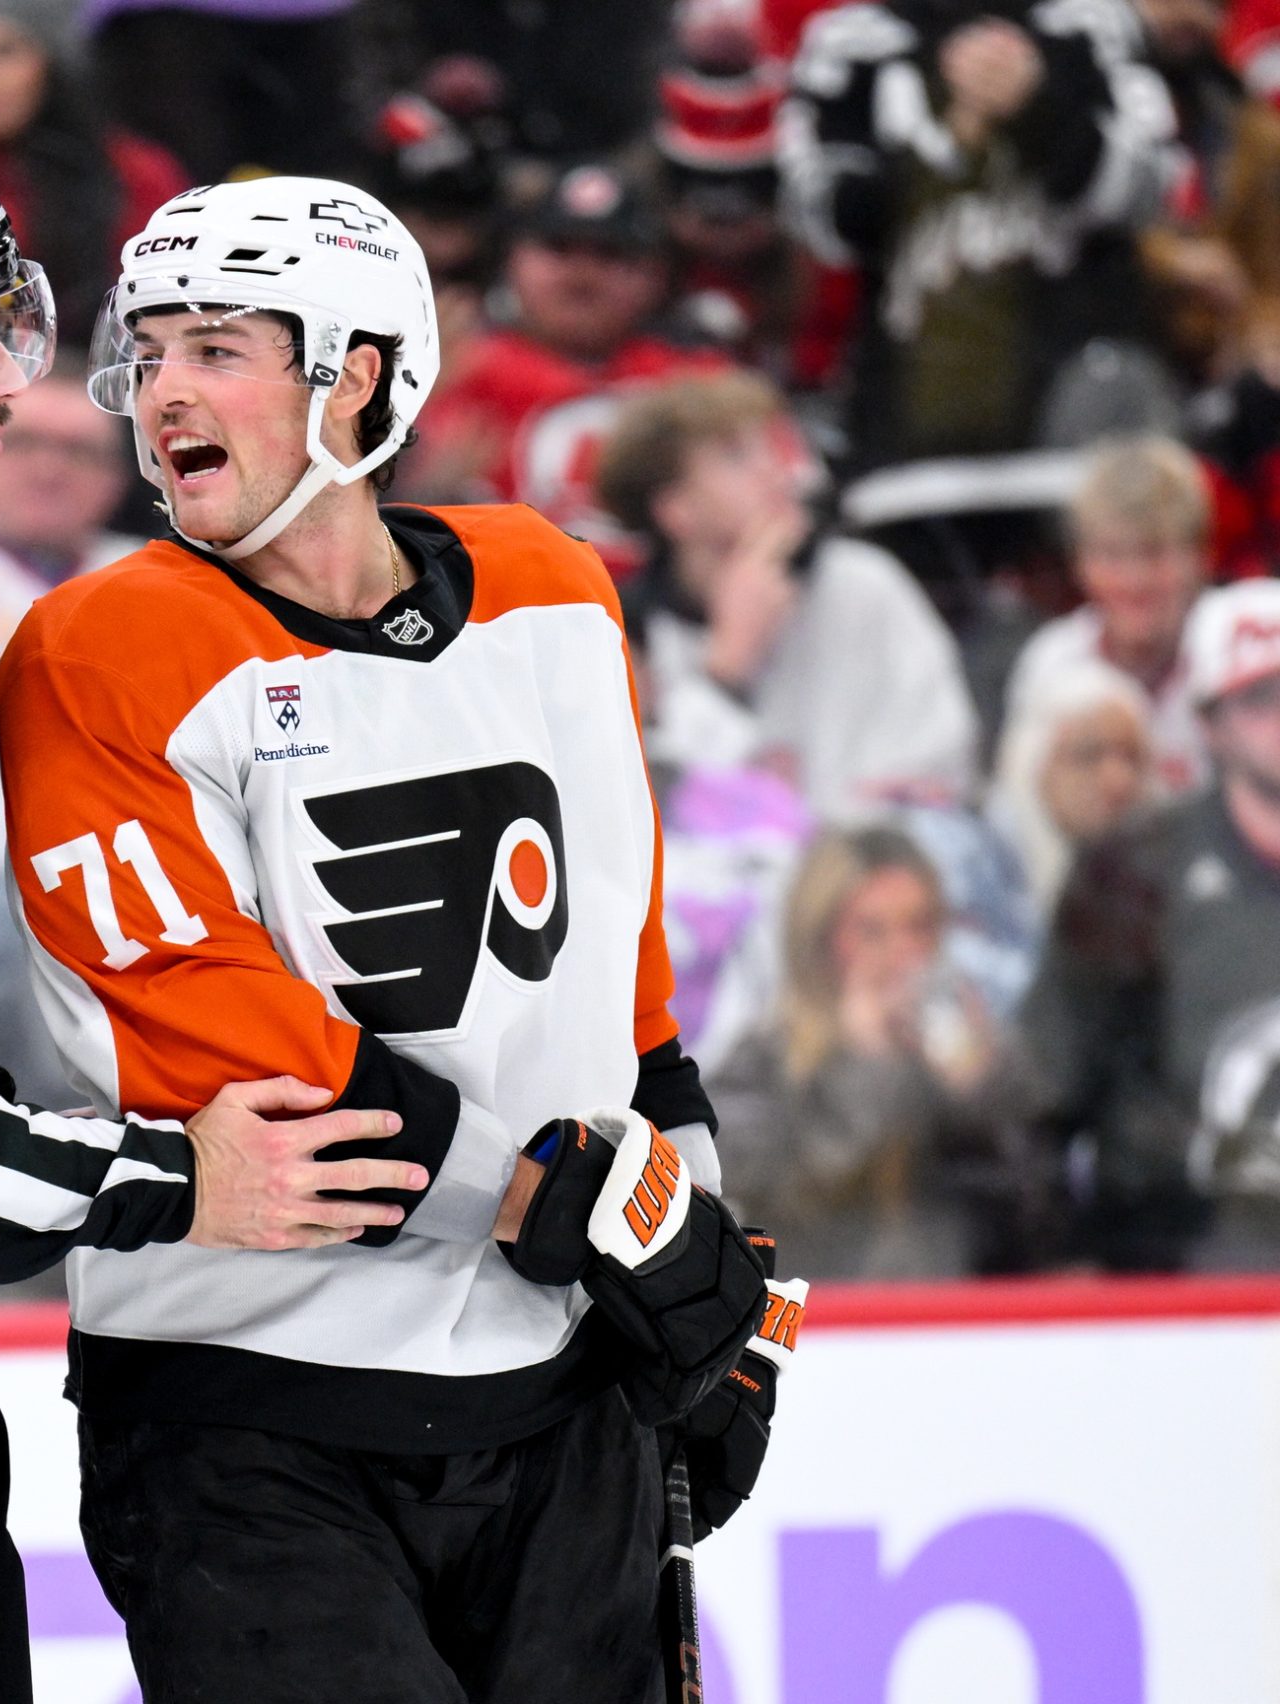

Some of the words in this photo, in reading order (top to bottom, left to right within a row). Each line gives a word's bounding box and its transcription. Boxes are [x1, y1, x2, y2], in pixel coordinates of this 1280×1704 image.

[134, 236, 199, 257] CCM
[315, 232, 400, 262] CHEVROLET
[29, 818, 210, 973] 71
